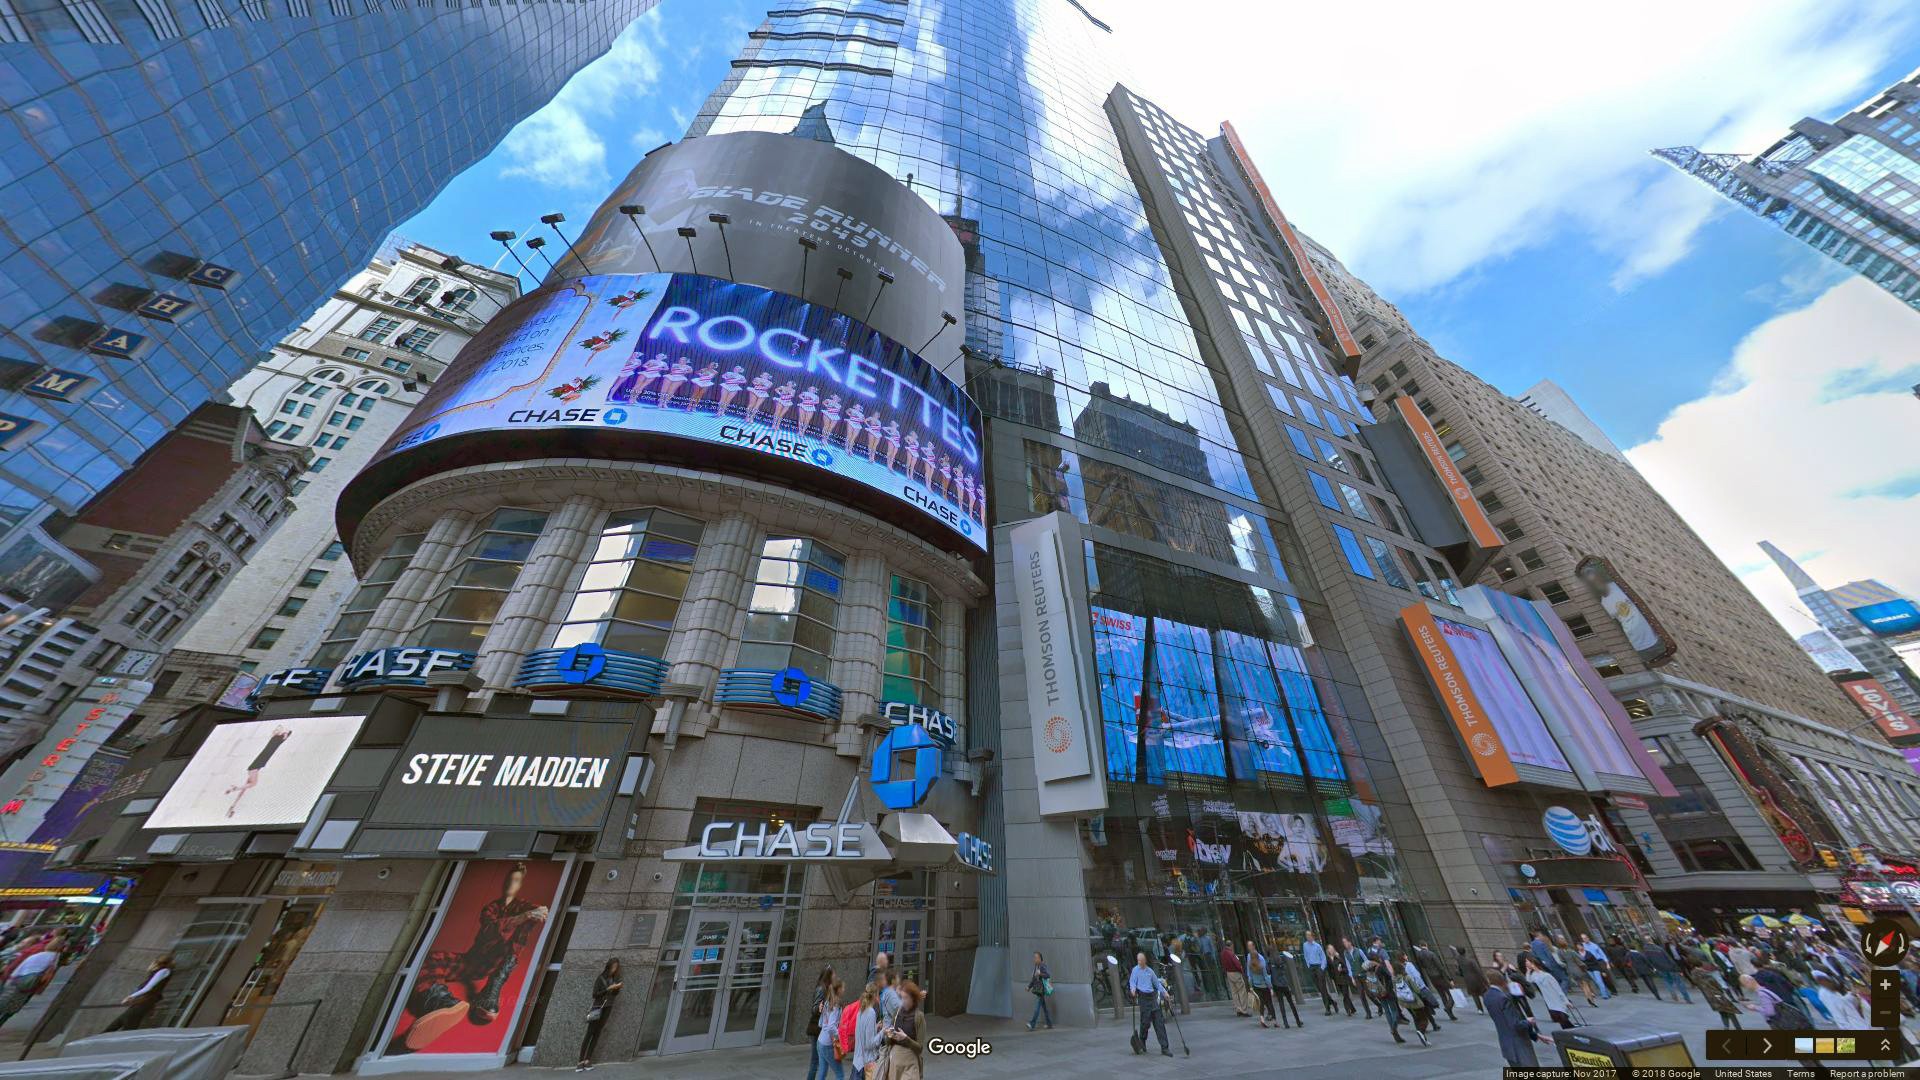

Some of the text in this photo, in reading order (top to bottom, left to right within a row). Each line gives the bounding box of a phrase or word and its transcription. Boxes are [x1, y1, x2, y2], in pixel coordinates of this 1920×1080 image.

[688, 185, 947, 293] BLADE RUNNER
[650, 305, 980, 465] ROCKETTES
[507, 408, 601, 423] CHASE
[719, 425, 808, 458] CHASE
[903, 485, 958, 527] CHASE
[1029, 550, 1060, 707] THOMSON REUTERS
[1100, 616, 1131, 631] SWISS
[338, 648, 462, 682] HASE
[1418, 624, 1450, 673] REUTERS
[1443, 671, 1478, 728] THOMSON
[884, 702, 958, 745] CHAS
[401, 753, 610, 788] STEVE MADDEN
[701, 822, 865, 857] CHASE
[958, 831, 993, 872] CHASE
